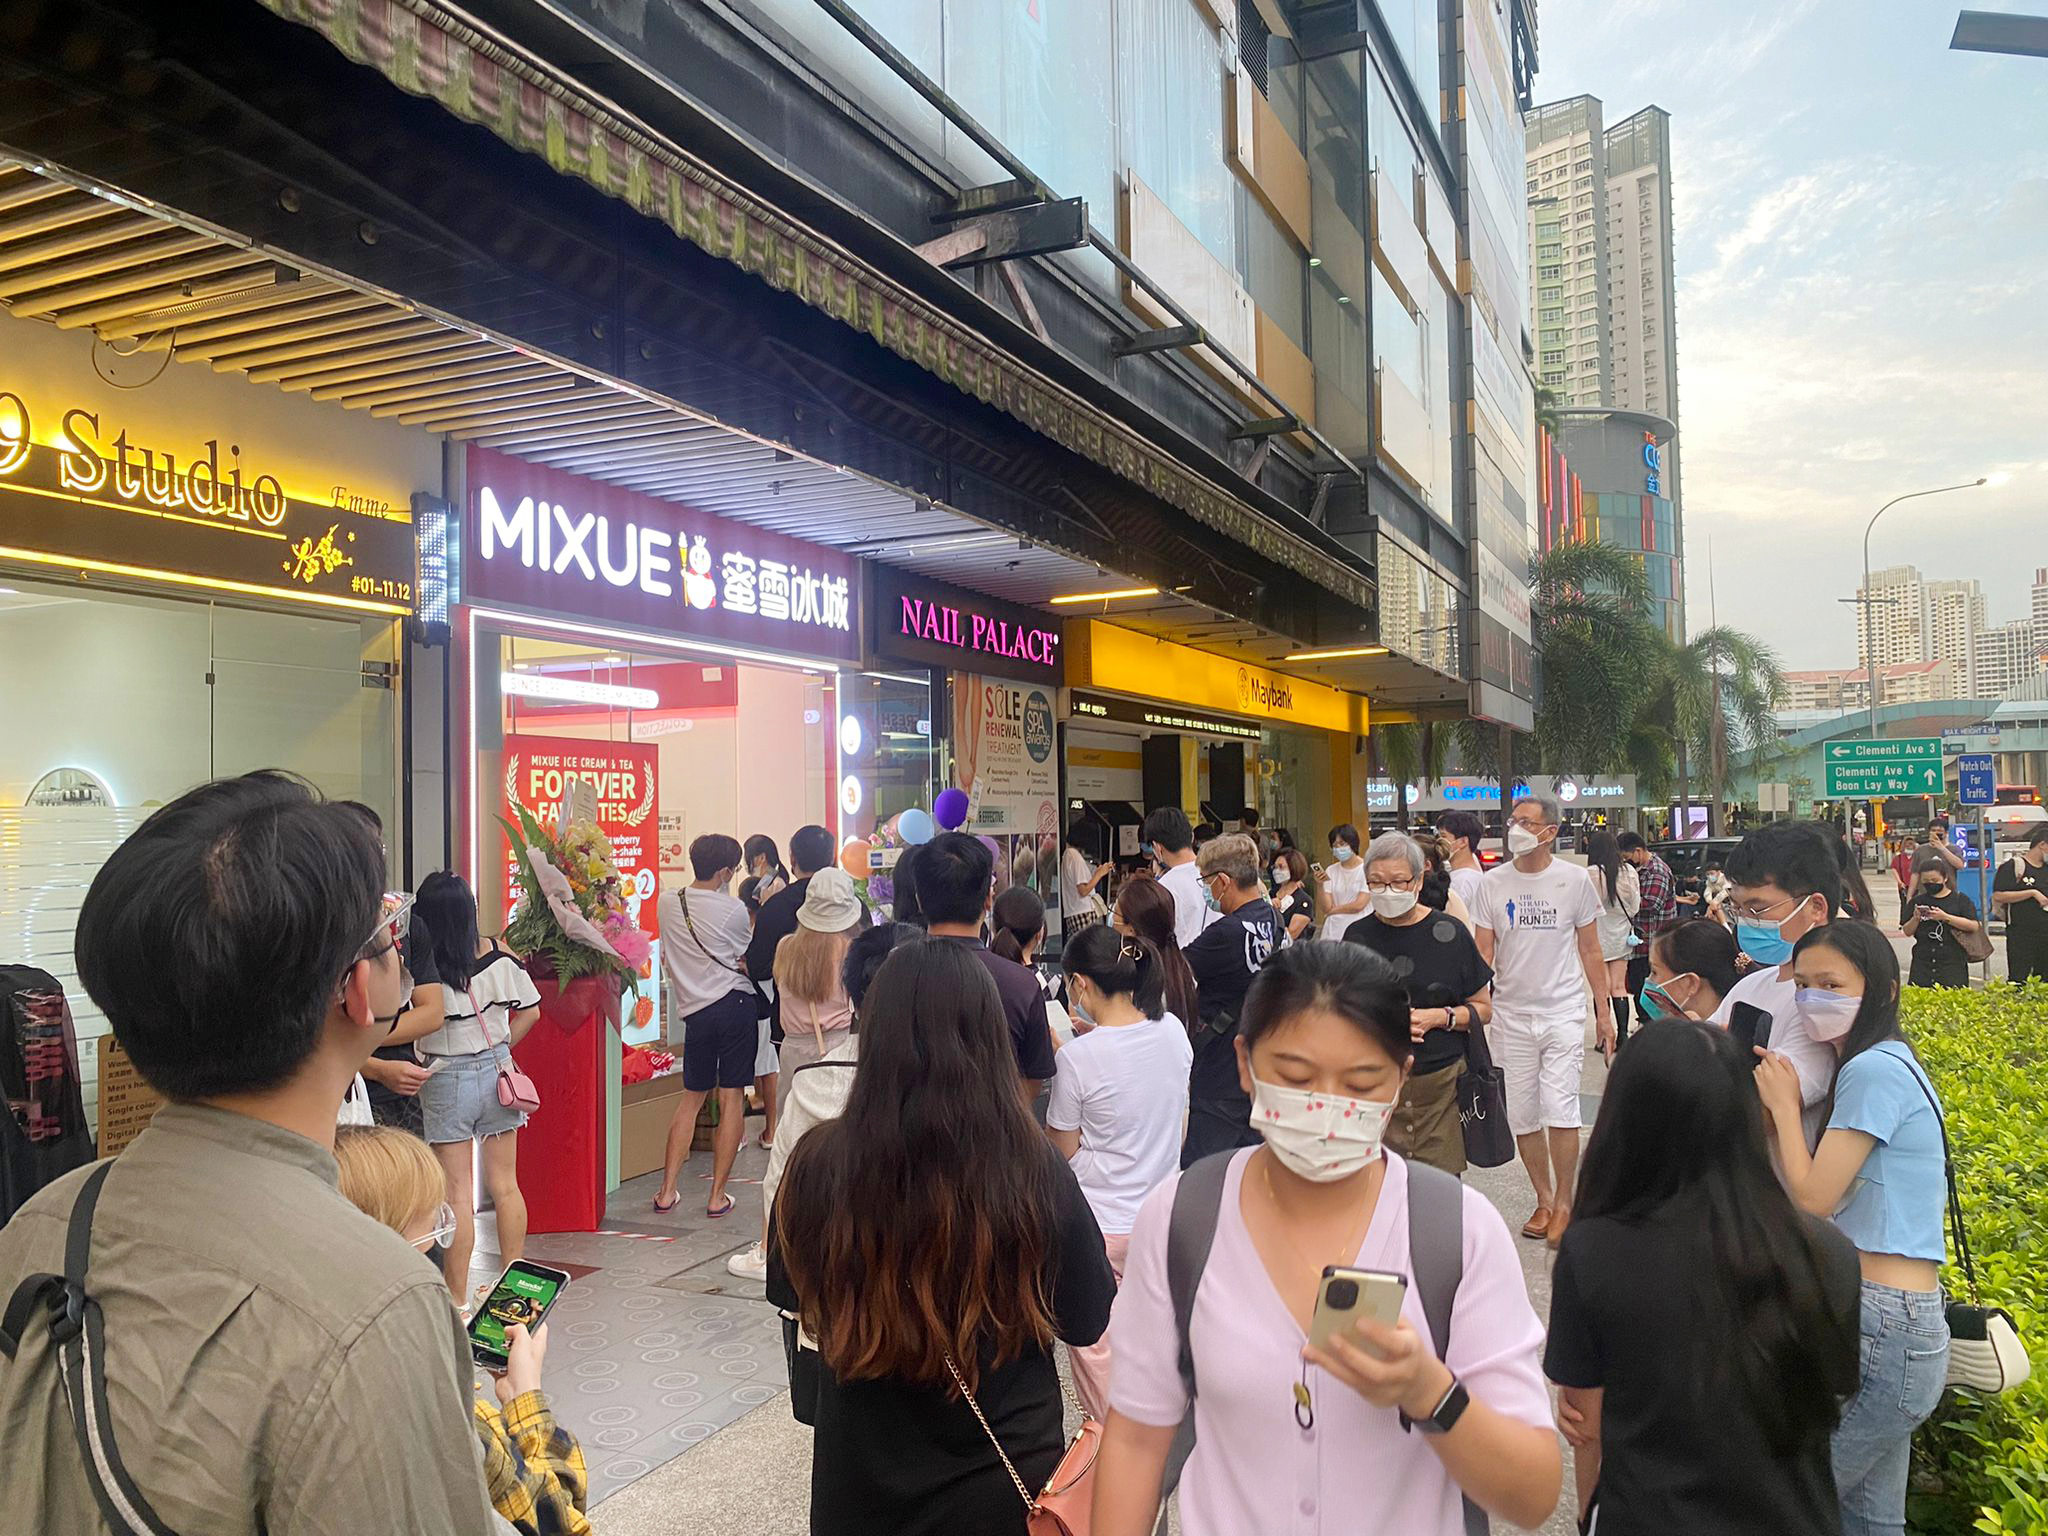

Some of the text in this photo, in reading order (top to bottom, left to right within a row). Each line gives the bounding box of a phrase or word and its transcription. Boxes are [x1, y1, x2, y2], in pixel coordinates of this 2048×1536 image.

[60, 408, 288, 527] Studio
[330, 485, 389, 518] Emme
[480, 486, 850, 632] MIXUE 蜜雪冰城
[351, 574, 411, 600] #01-11.12
[900, 596, 965, 649] NAIL
[971, 614, 1055, 667] PALACE
[1251, 677, 1294, 712] Maybank
[1027, 710, 1046, 735] SPA
[985, 722, 1022, 739] RENEWAL
[986, 740, 1022, 755] TREATMENT
[1855, 743, 1936, 756] Clementi Ave 3
[531, 755, 560, 767] MIXUE
[563, 756, 578, 768] ICE
[580, 757, 607, 769] CREAM
[619, 759, 634, 770] TEA
[1959, 759, 1992, 772] Watch Out
[1835, 764, 1915, 777] Clementi Ave 6
[1836, 779, 1908, 792] Boon Lay Way
[1970, 774, 1982, 785] For
[1581, 784, 1625, 798] car park
[1966, 787, 1988, 799] Traffic
[640, 873, 650, 895] 2
[1519, 914, 1541, 926] RUN
[107, 1082, 132, 1092] Men's
[107, 1105, 135, 1115] Single
[107, 1127, 136, 1140] Digital
